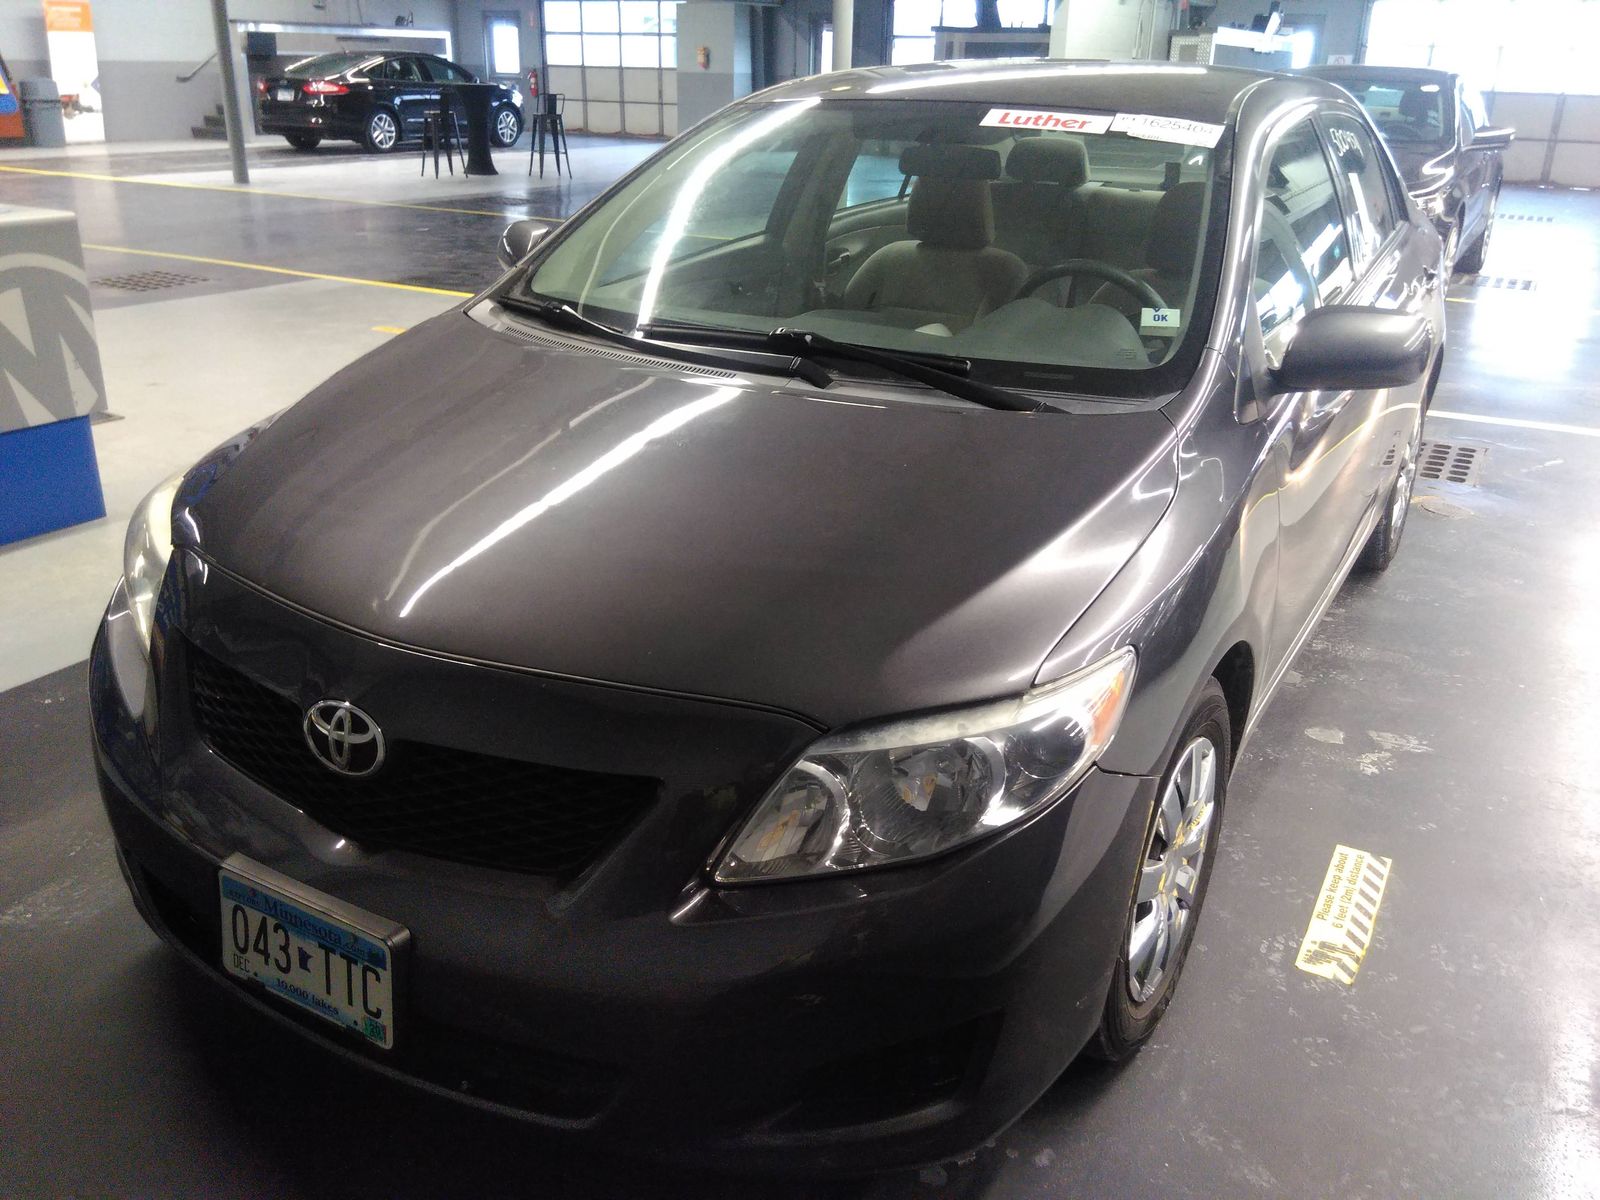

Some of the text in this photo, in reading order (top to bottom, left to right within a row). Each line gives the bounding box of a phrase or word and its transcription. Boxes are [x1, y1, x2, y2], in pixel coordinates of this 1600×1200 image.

[998, 111, 1093, 130] Luther
[1153, 313, 1168, 322] OK
[1316, 852, 1349, 920] Please keep about
[1333, 906, 1349, 922] feet
[1346, 854, 1365, 886] distance
[233, 953, 250, 974] DEC
[312, 993, 340, 1015] lakes
